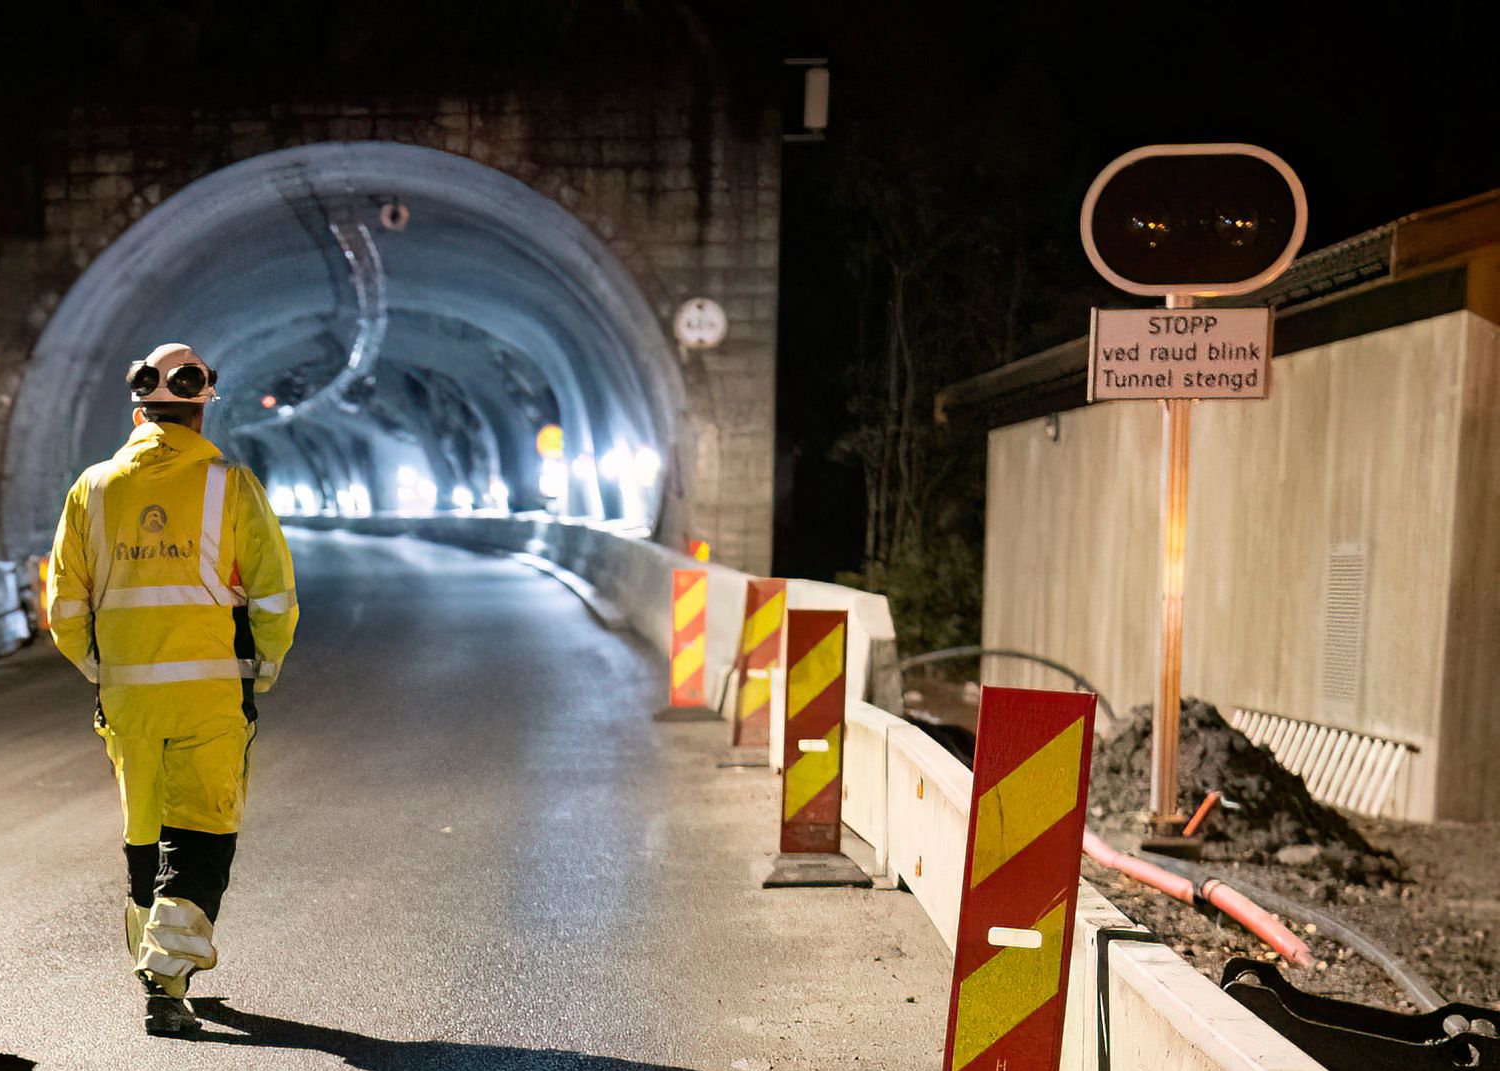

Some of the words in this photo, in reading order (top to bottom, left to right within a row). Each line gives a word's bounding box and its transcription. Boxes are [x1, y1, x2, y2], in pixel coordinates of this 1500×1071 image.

[1148, 315, 1218, 335] STOPP
[1102, 342, 1140, 361] ved
[1149, 342, 1198, 361] raud
[1208, 341, 1261, 361] blink
[1103, 369, 1173, 388] Tunnel
[1183, 368, 1258, 392] stengd
